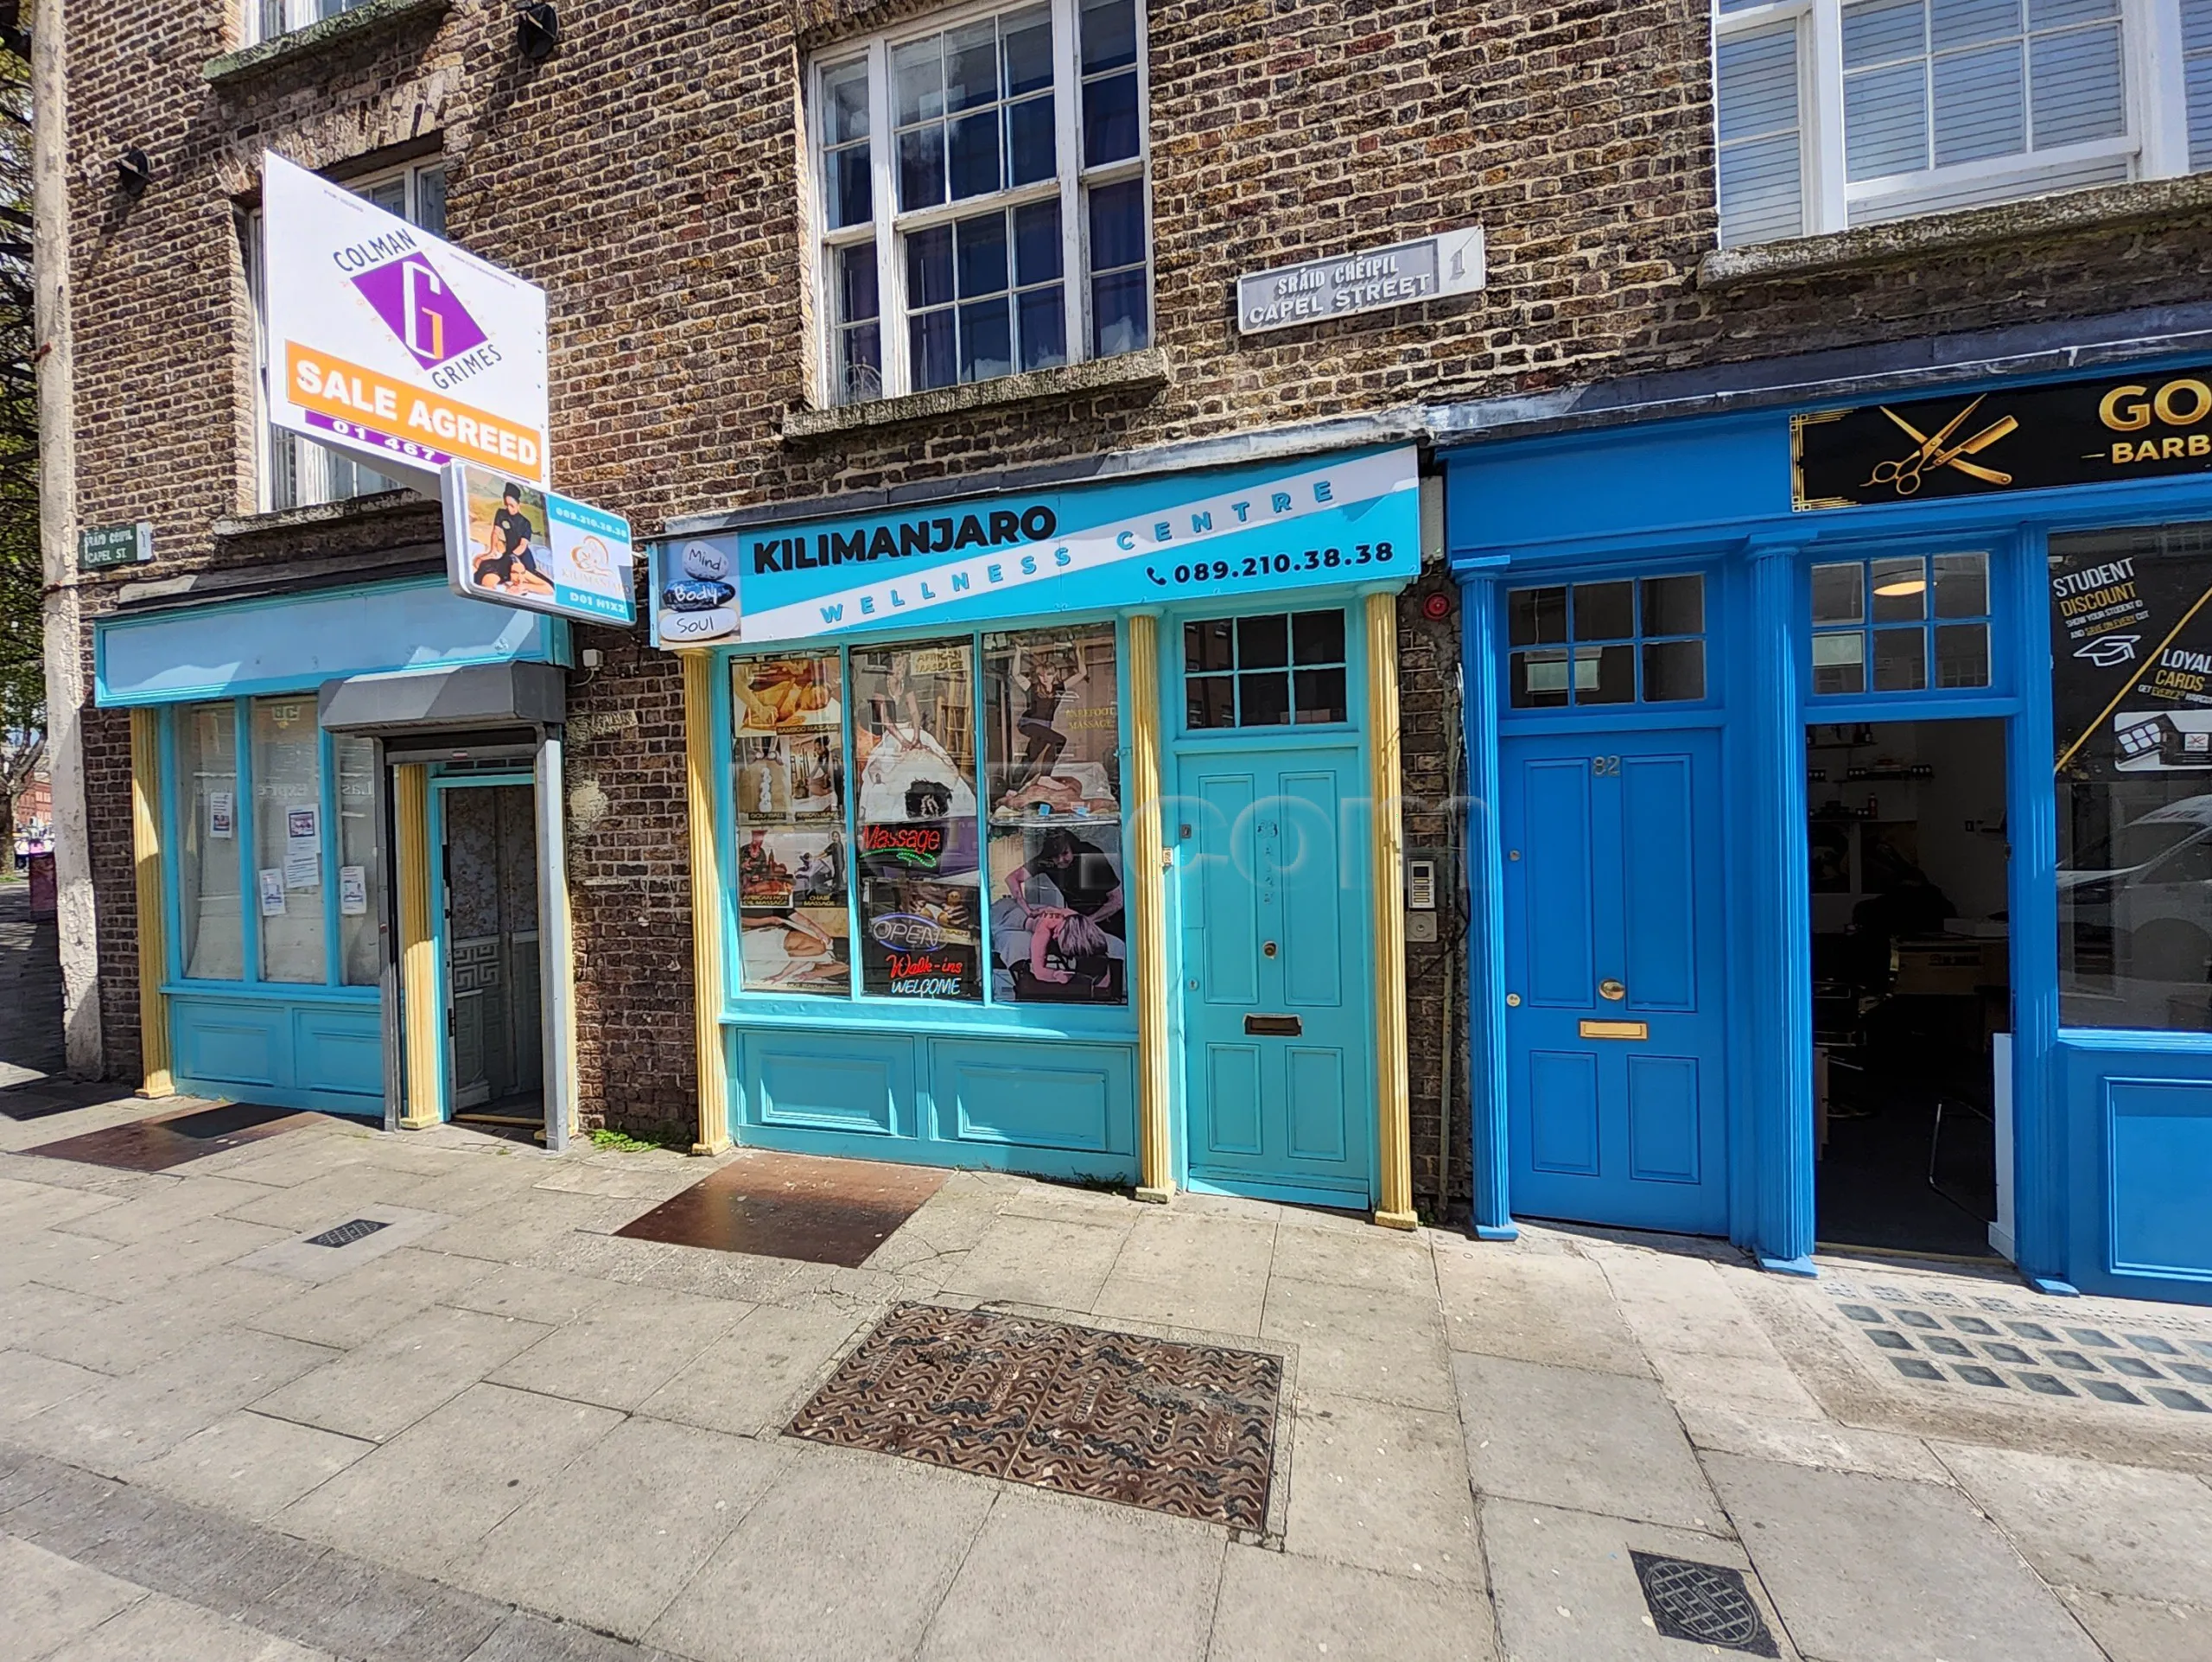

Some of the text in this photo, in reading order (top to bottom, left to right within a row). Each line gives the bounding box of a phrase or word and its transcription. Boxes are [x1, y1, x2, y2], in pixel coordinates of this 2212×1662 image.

[334, 228, 417, 271] COLMAN
[1249, 273, 1430, 324] CAPEL STREET
[432, 344, 502, 390] GRIMES
[296, 360, 537, 466] SALE AGREED
[2099, 379, 2212, 431] GO
[333, 420, 435, 461] 01 467
[2112, 434, 2212, 464] BARB
[1116, 481, 1333, 551] CENTRE
[753, 505, 1057, 575] KILIMANJARO
[689, 548, 722, 570] Mind
[1173, 542, 1394, 584] 089.210.38.38
[820, 547, 1071, 624] WELLNESS
[2053, 557, 2135, 597] STUDENT
[674, 585, 718, 605] Body
[2060, 582, 2137, 617] DISCOUNT
[2087, 611, 2106, 622] YOUR
[2105, 601, 2135, 616] STUDENT
[677, 616, 714, 634] Soul
[2161, 648, 2212, 674] LOYAL
[2155, 669, 2206, 692] CARDS
[862, 824, 941, 855] Massage
[873, 920, 941, 947] OPEN
[885, 953, 963, 978] Walk-ins
[891, 977, 963, 996] WELCOME
